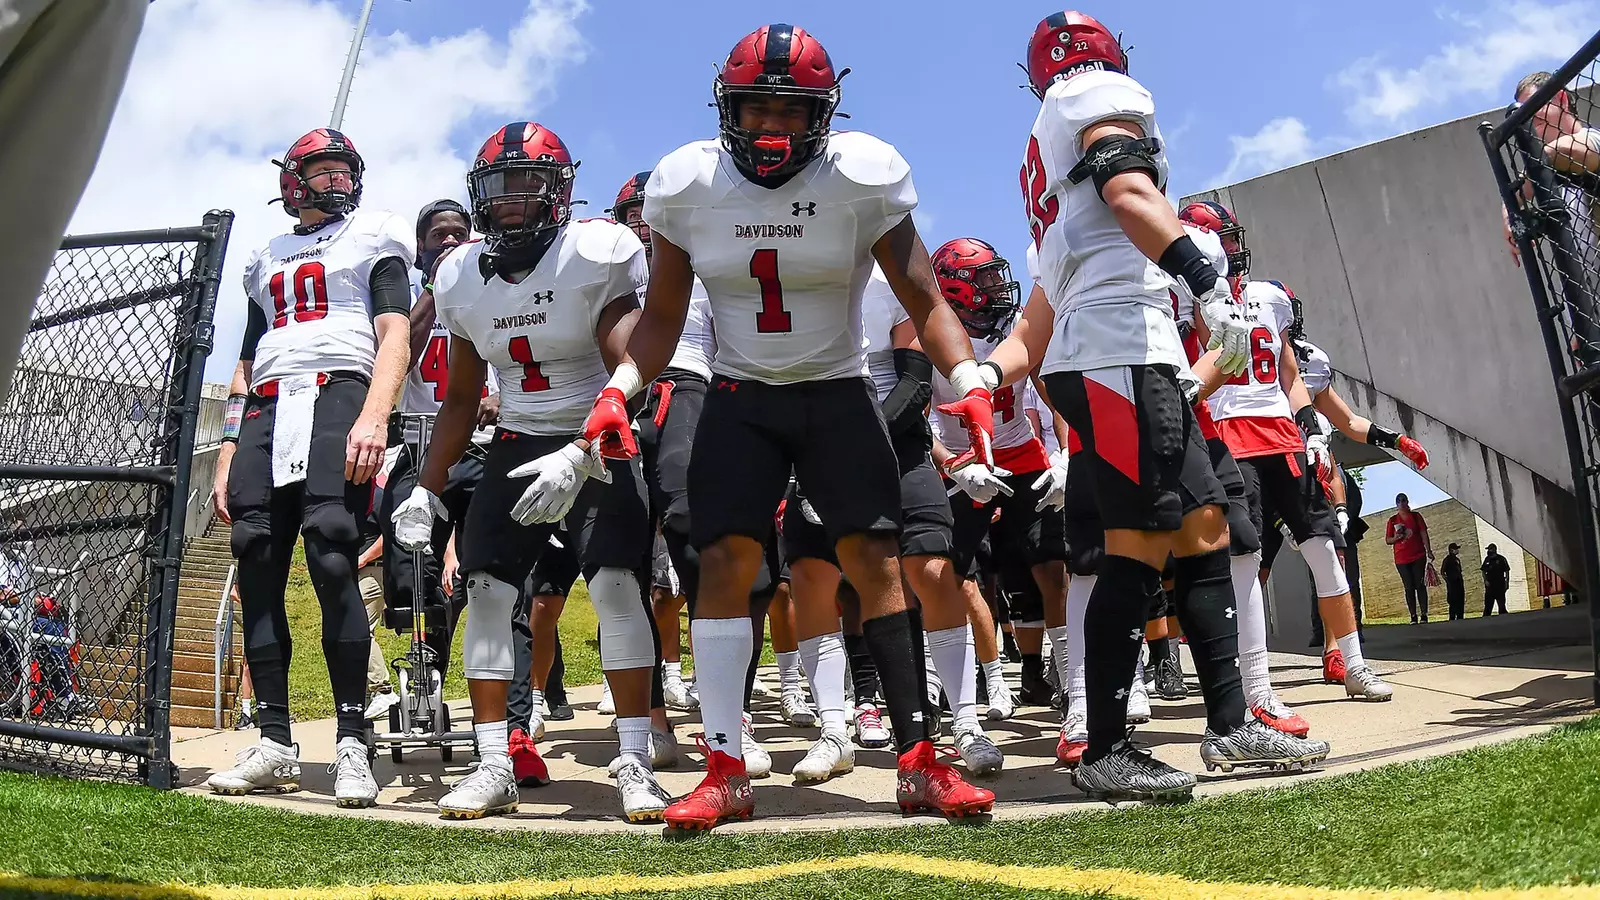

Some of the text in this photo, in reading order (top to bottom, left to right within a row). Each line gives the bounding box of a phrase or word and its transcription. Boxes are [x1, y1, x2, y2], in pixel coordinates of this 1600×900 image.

[1074, 41, 1089, 51] 22
[767, 75, 782, 84] WE
[734, 224, 804, 238] DAVIDSON
[280, 247, 323, 266] DAVIDSON
[268, 260, 329, 330] 10
[748, 248, 793, 334] 1
[492, 311, 547, 330] DAVIDSON
[507, 334, 552, 393] 1
